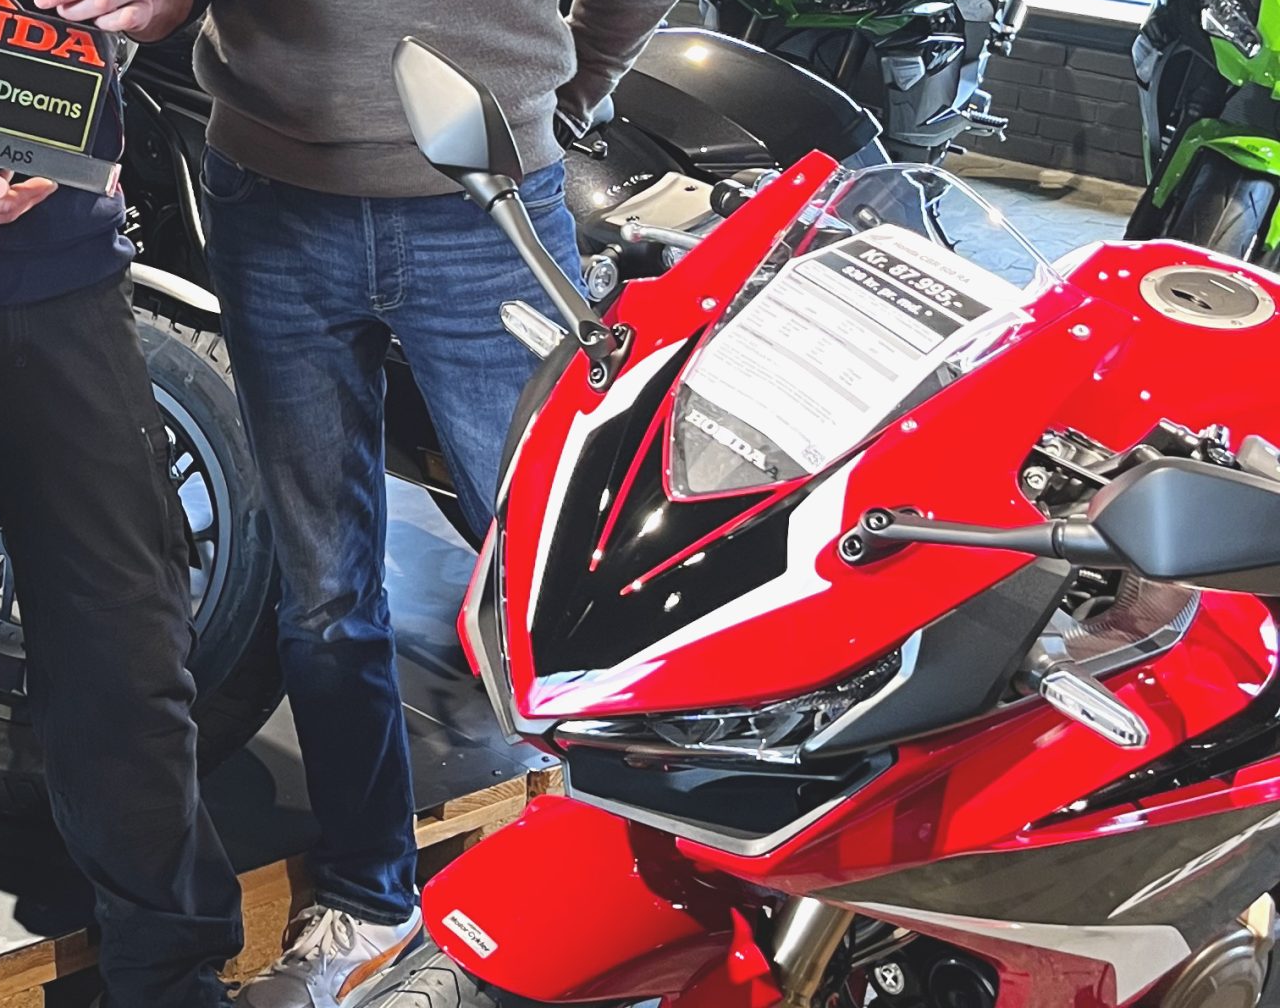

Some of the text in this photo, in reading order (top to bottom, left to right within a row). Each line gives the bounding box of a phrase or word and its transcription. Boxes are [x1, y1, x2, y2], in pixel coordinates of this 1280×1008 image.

[0, 144, 34, 164] ApS
[858, 248, 963, 307] Kr. 87.995,-
